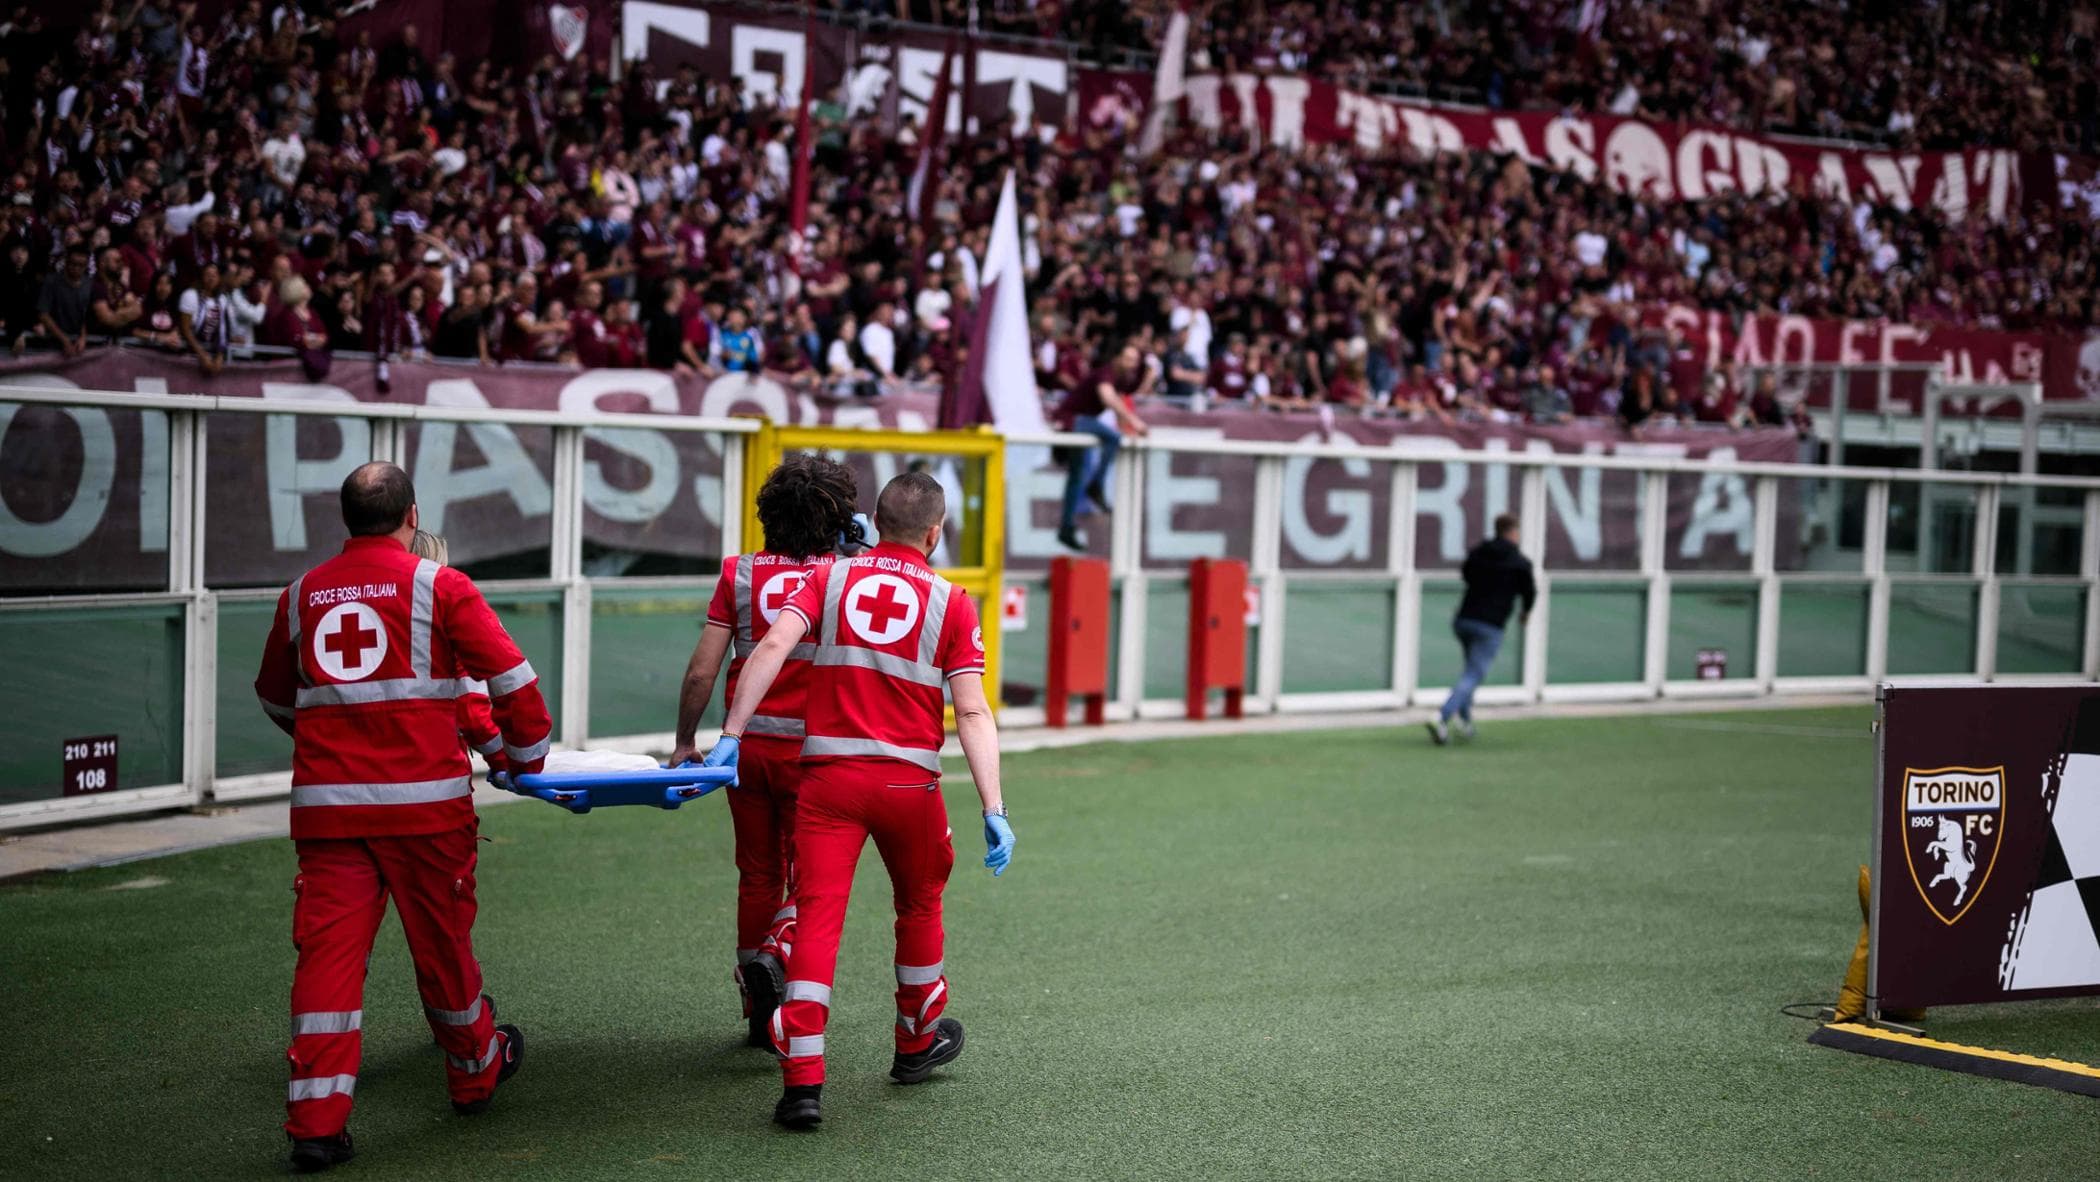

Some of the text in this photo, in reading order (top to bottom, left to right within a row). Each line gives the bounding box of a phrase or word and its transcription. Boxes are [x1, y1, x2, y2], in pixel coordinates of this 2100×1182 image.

[851, 556, 936, 584] CROCE ROSSA ITALIANA
[309, 582, 397, 607] CROCE ROSSA ITALIANA
[65, 740, 115, 760] 210 211
[76, 767, 106, 790] 108
[1914, 780, 1994, 804] TORINO
[1911, 814, 1993, 836] 1906 FC
